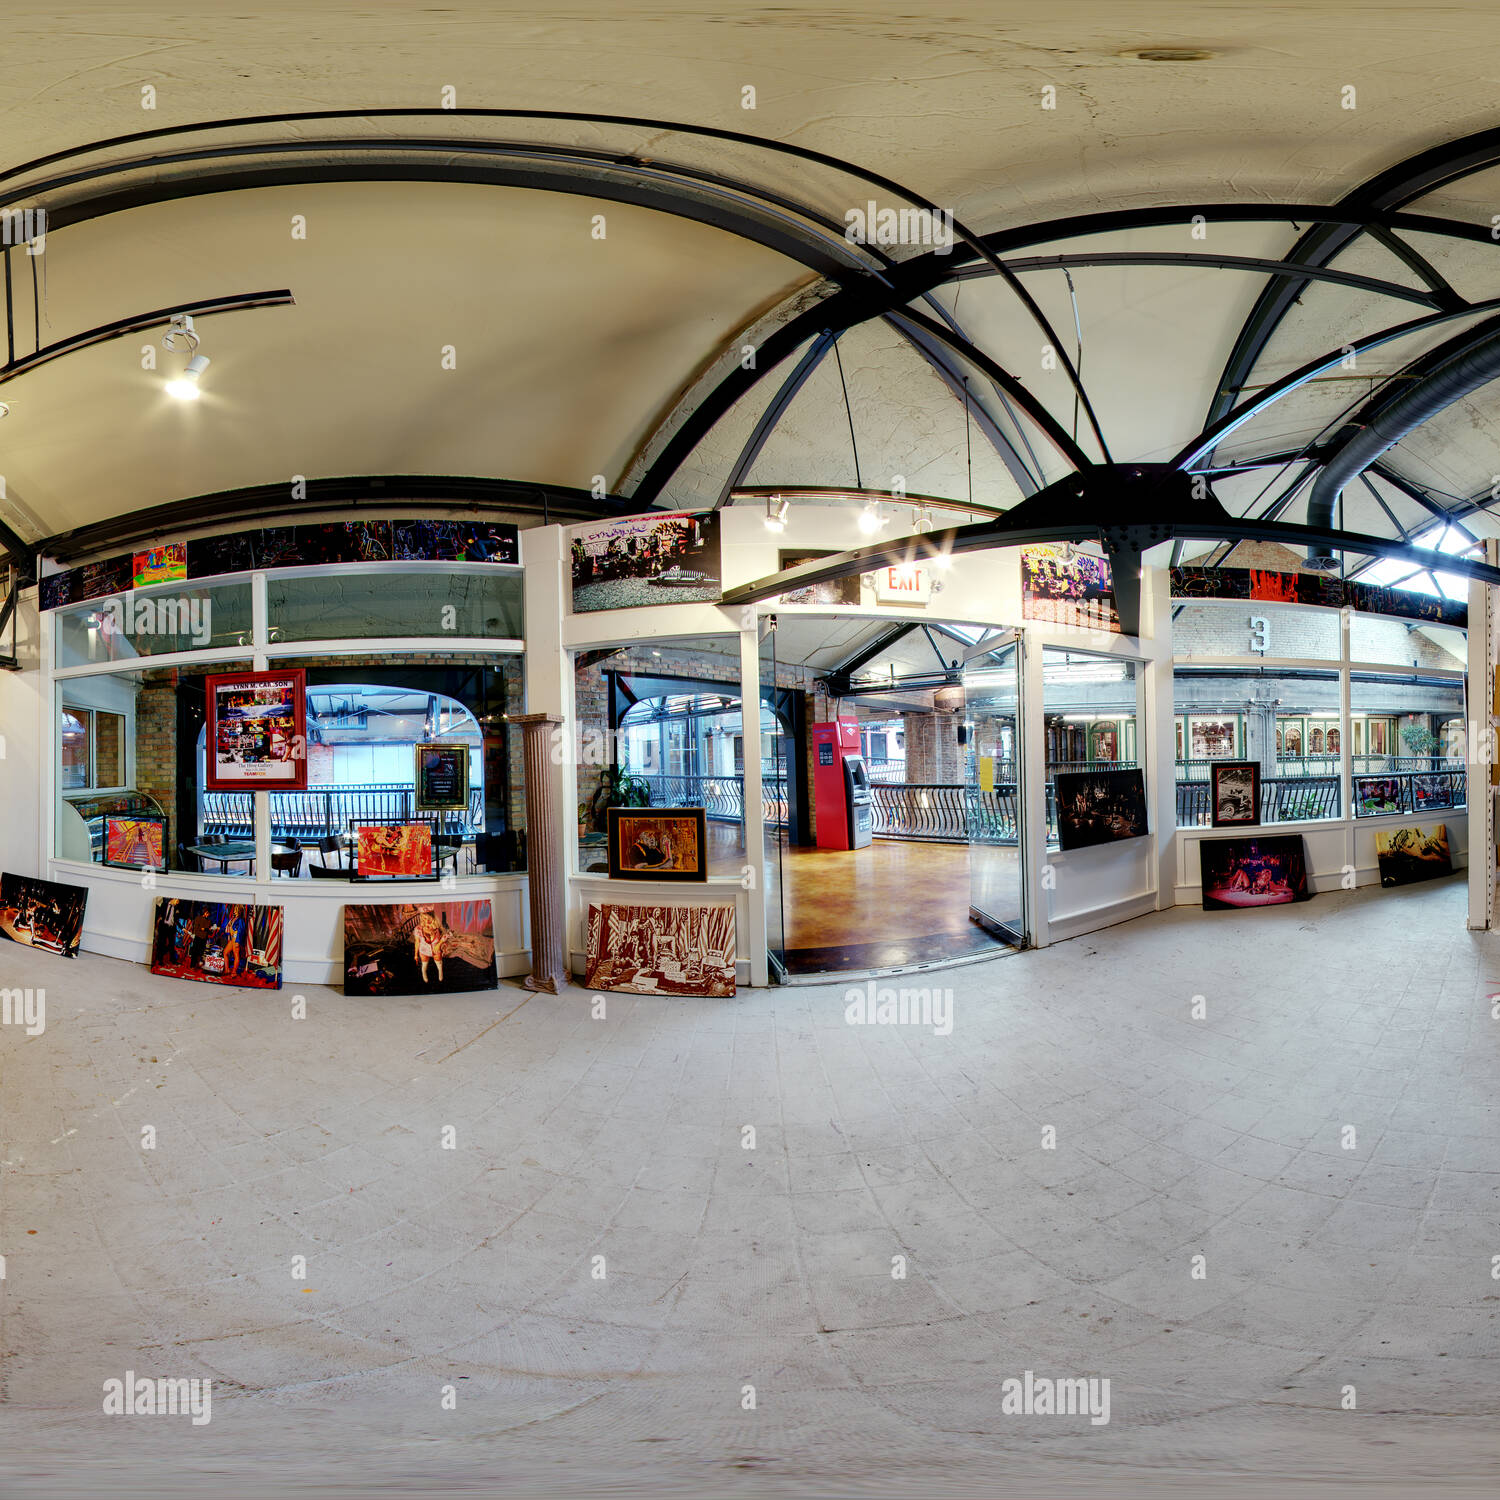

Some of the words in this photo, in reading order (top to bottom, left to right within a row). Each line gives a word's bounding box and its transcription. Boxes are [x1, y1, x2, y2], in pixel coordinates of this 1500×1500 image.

[1249, 615, 1270, 651] 3
[233, 682, 249, 690] LYNN
[259, 680, 288, 688] CARSON
